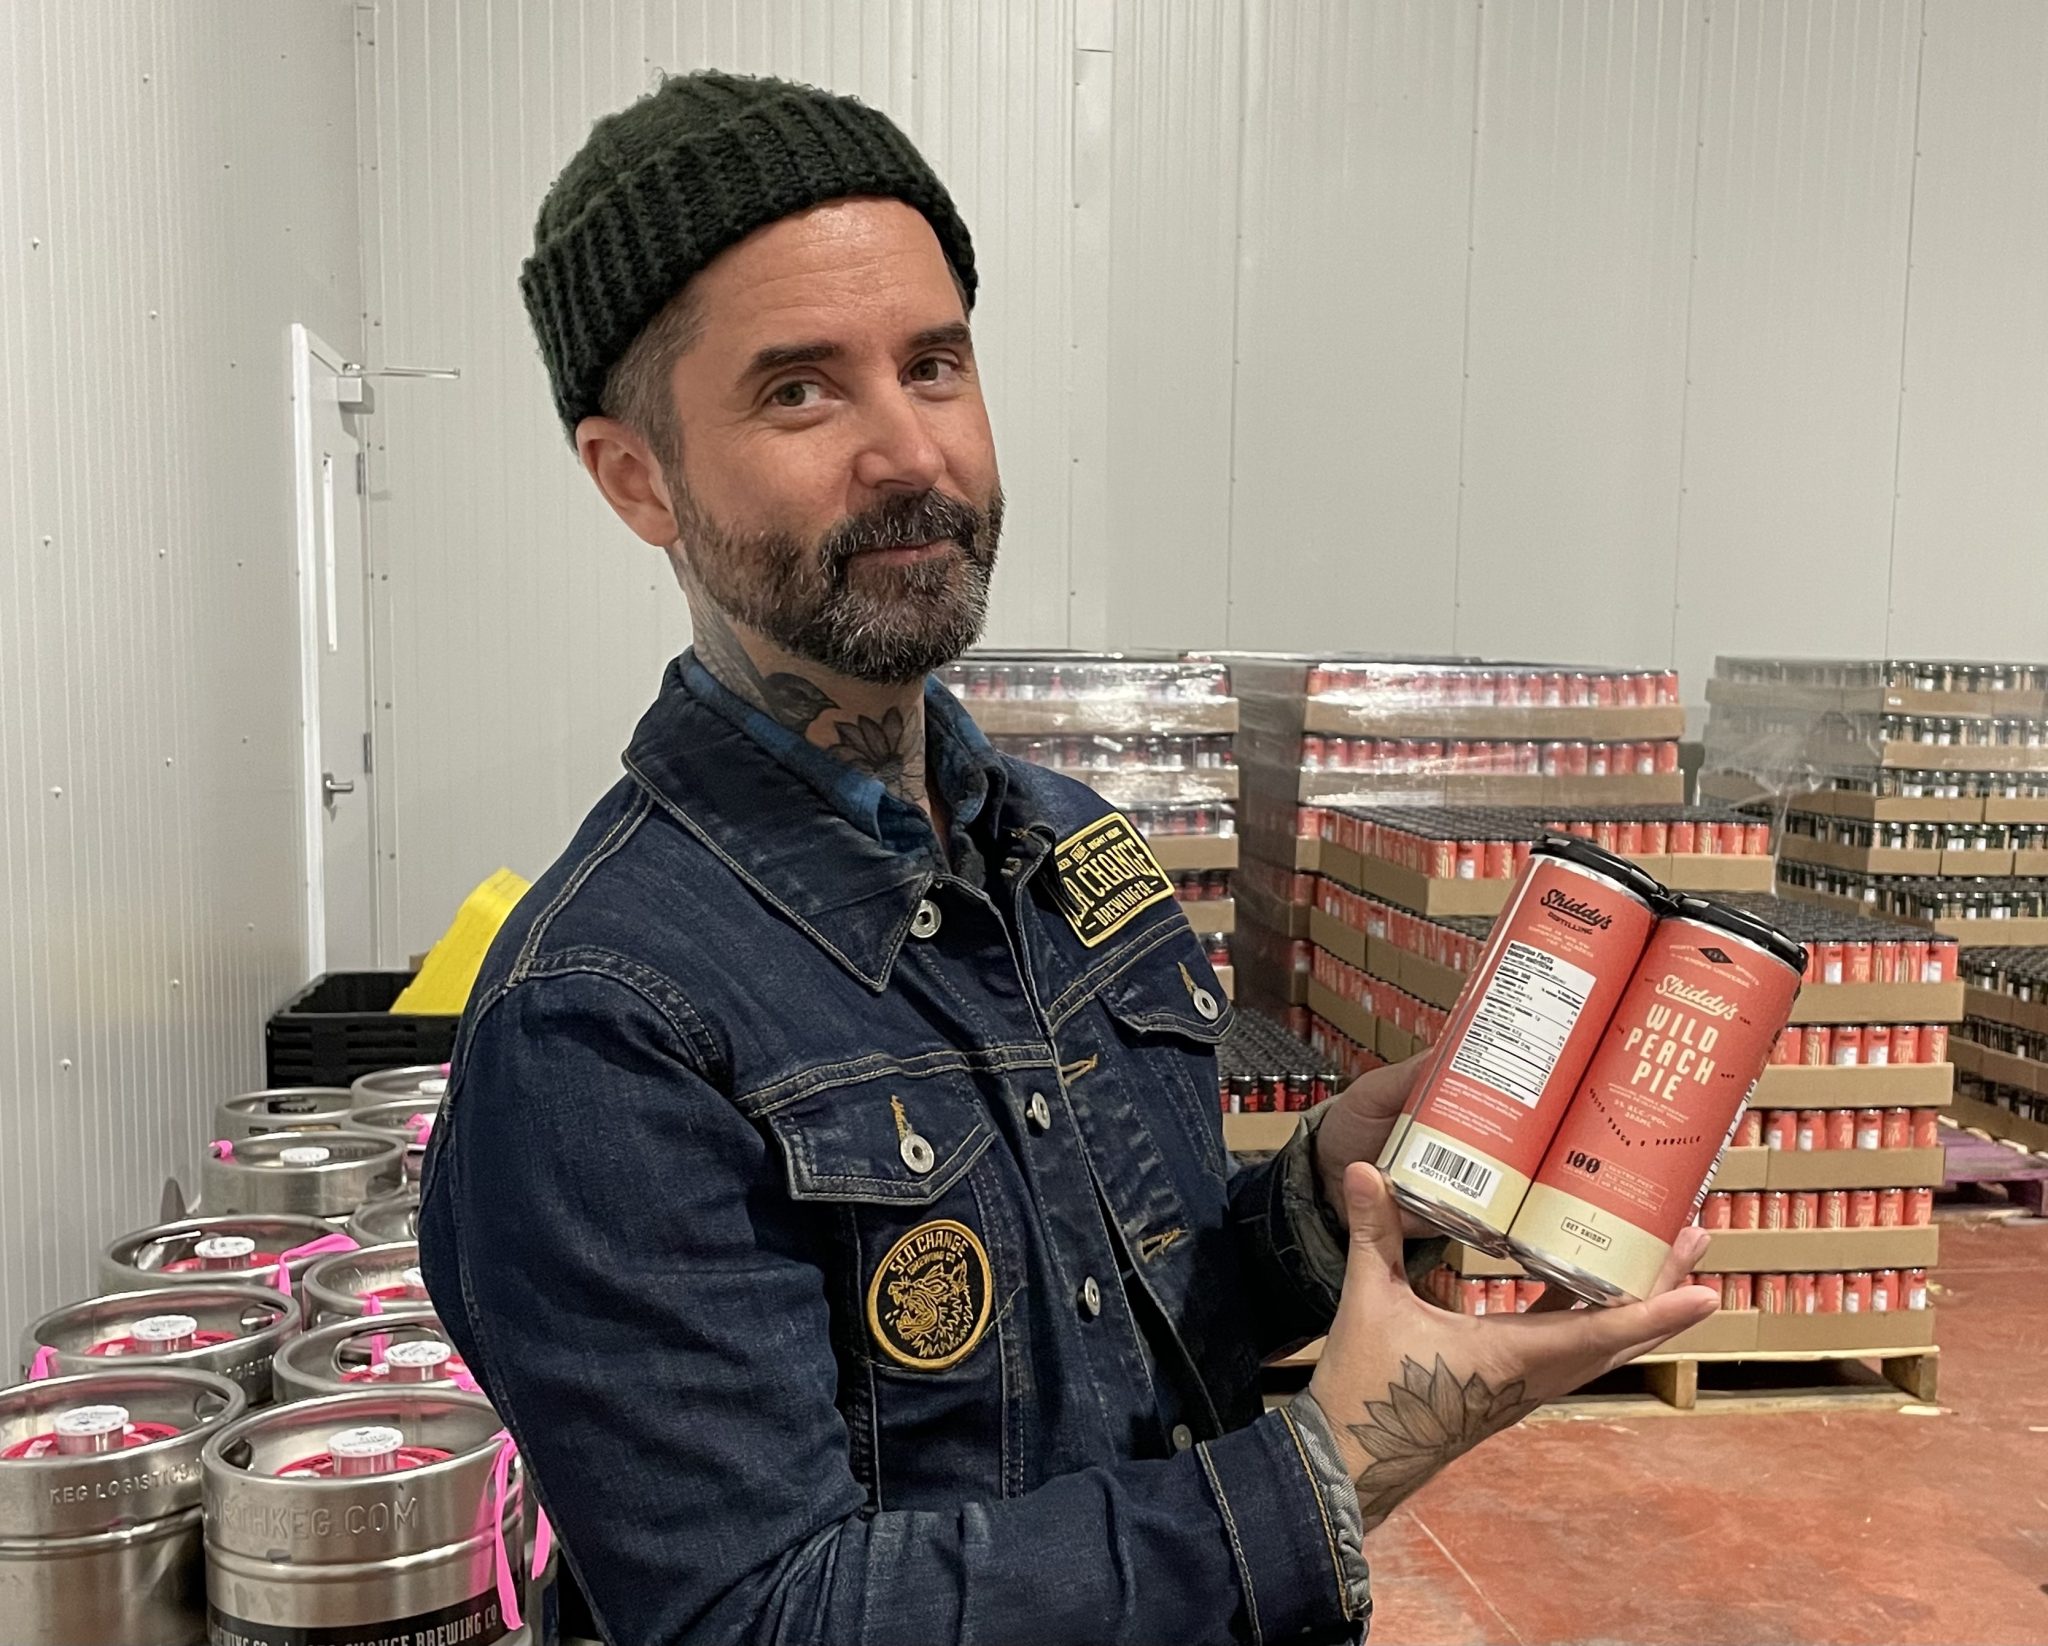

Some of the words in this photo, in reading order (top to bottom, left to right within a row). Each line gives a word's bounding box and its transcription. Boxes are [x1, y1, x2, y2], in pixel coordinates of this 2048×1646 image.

[1076, 837, 1160, 897] CHANGE
[1093, 885, 1142, 927] BREWING
[1540, 888, 1613, 930] Shiddy's
[1547, 911, 1593, 935] DISTILLING
[1655, 974, 1740, 1021] Shiddy's
[1646, 1003, 1719, 1053] WILD
[1624, 1027, 1716, 1085] PEACH
[1630, 1060, 1683, 1101] PIE
[1566, 1150, 1601, 1174] 100
[889, 1244, 917, 1275] SEA
[915, 1230, 969, 1258] CHANGE
[1565, 1221, 1579, 1234] GET
[1580, 1226, 1606, 1245] SHIDDY
[50, 1484, 88, 1504] KEG
[415, 1612, 482, 1646] BREWING
